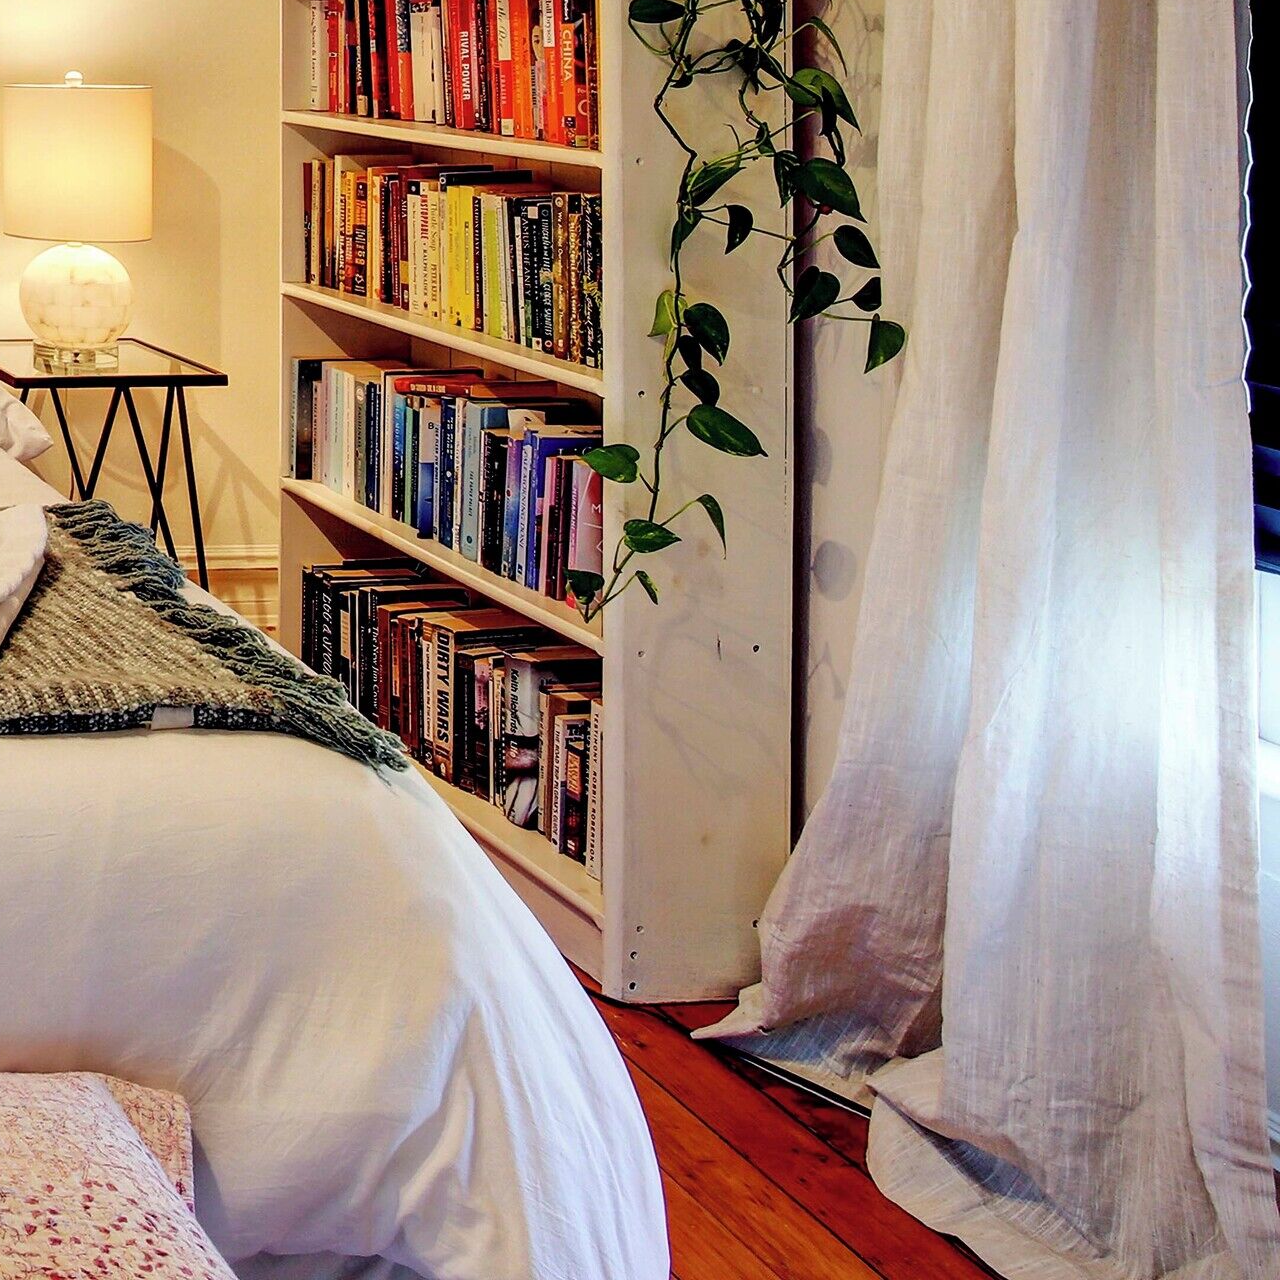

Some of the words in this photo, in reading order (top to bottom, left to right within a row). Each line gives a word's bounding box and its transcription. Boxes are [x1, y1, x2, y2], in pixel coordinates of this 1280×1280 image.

[460, 31, 469, 60] RIVAL
[544, 16, 553, 44] bryson
[563, 30, 572, 82] CHINA
[462, 64, 470, 100] POWER
[420, 194, 428, 240] UNSTOPPABLE
[521, 206, 529, 248] SEAMUS
[558, 212, 562, 222] We
[430, 232, 438, 252] Soup
[322, 593, 332, 624] EGG
[437, 632, 450, 686] DIRTY
[510, 669, 518, 692] Keith
[437, 689, 450, 743] WARS
[510, 694, 519, 734] Richards
